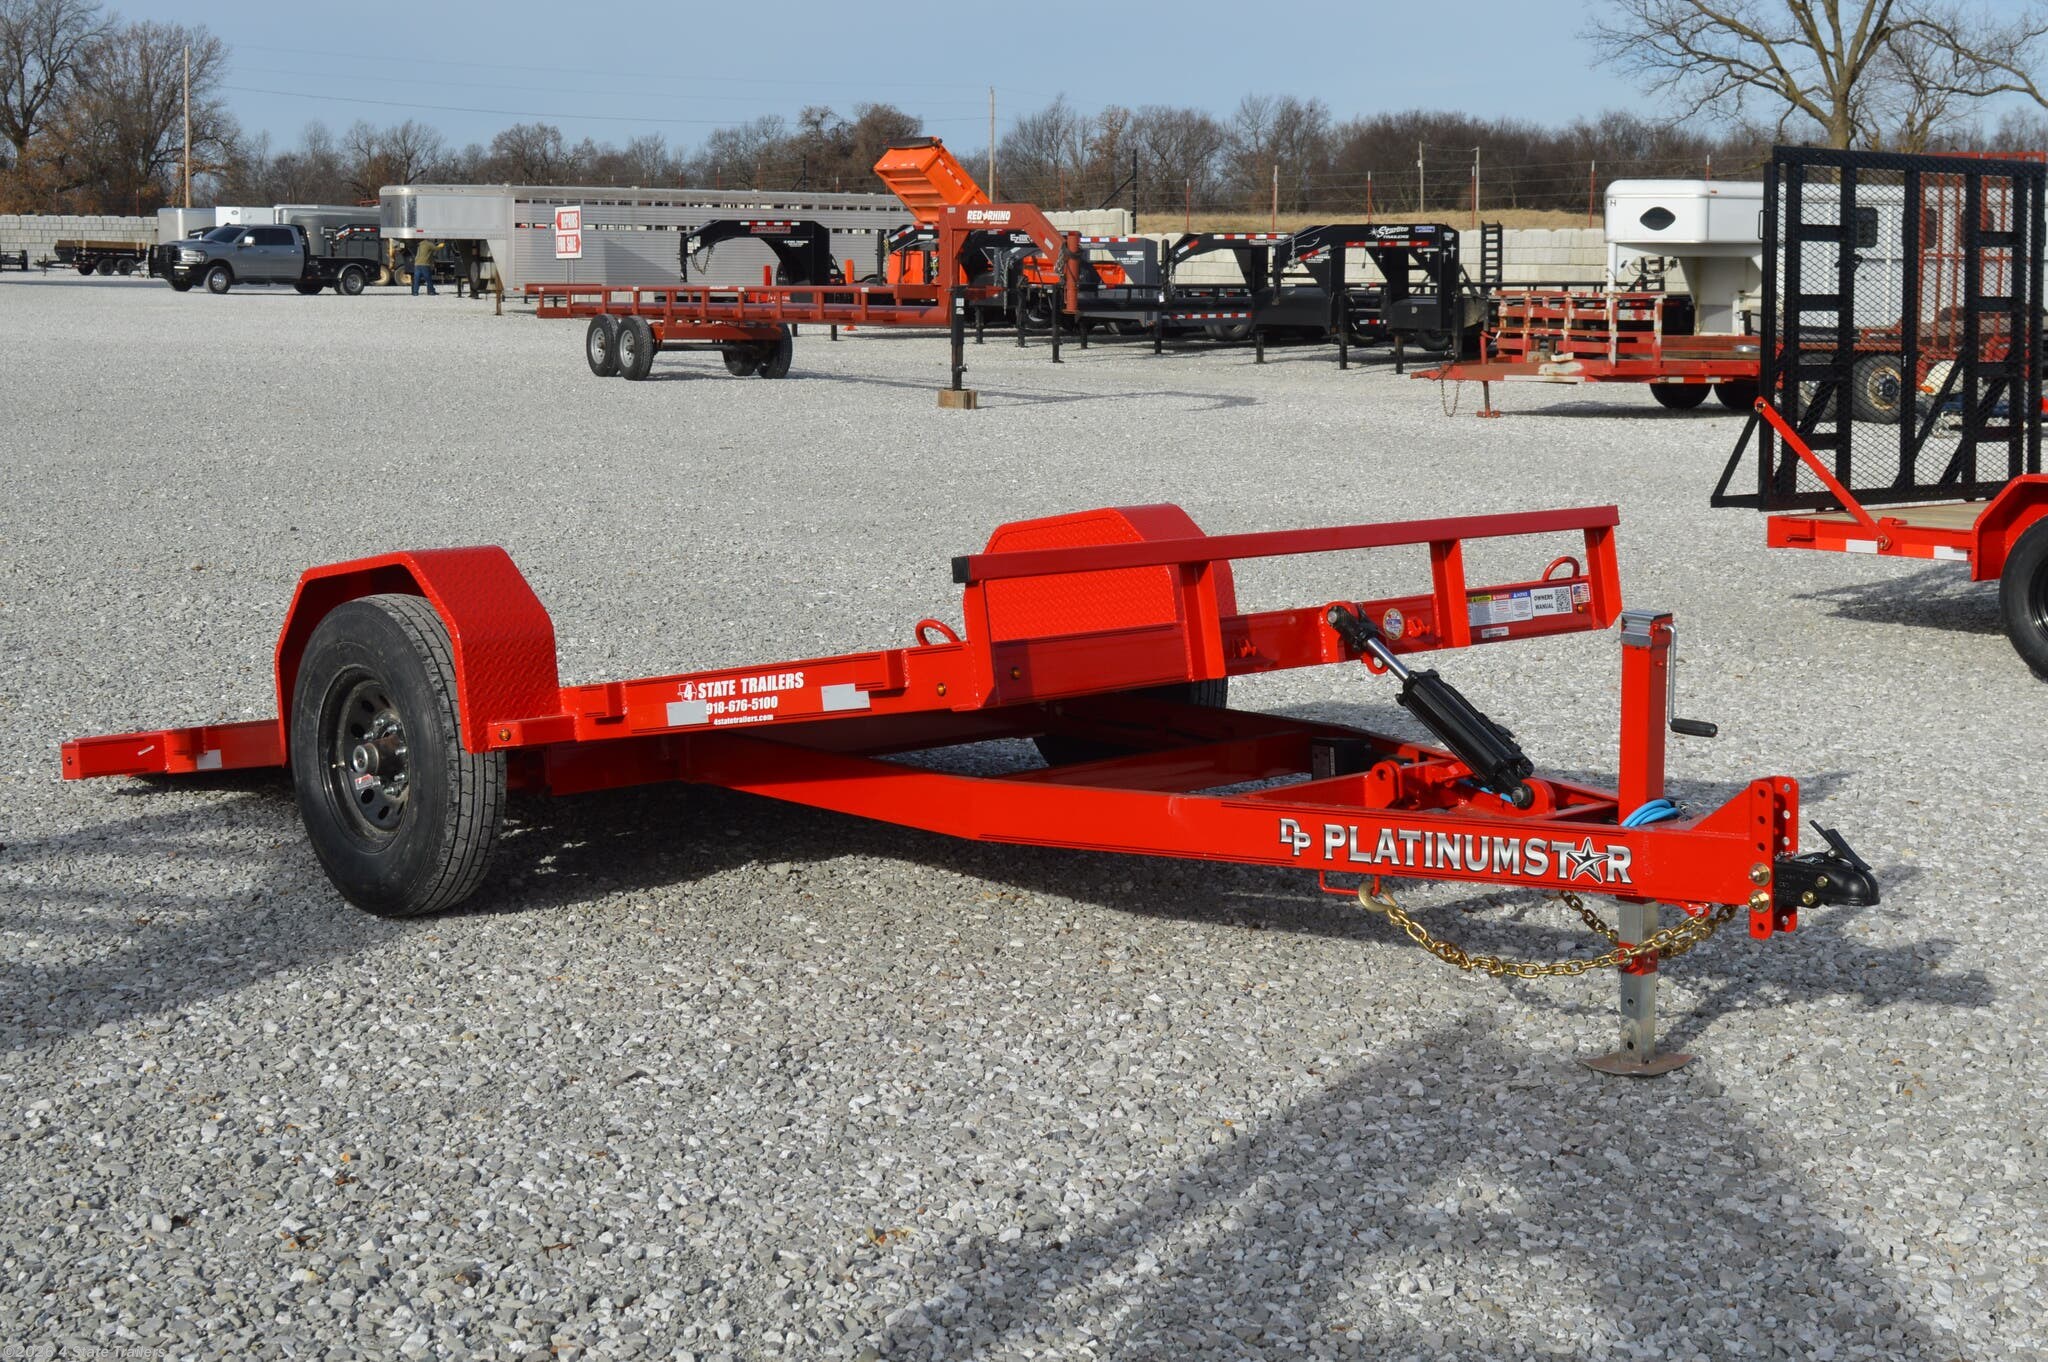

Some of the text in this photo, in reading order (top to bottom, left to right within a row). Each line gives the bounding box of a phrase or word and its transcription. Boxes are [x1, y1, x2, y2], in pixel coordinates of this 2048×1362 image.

[967, 210, 1011, 221] RED RHINO
[698, 680, 736, 699] STATE
[741, 672, 805, 694] TRAILERS
[705, 696, 779, 715] 918-676-5100
[713, 714, 774, 726] 4statetrailers.com
